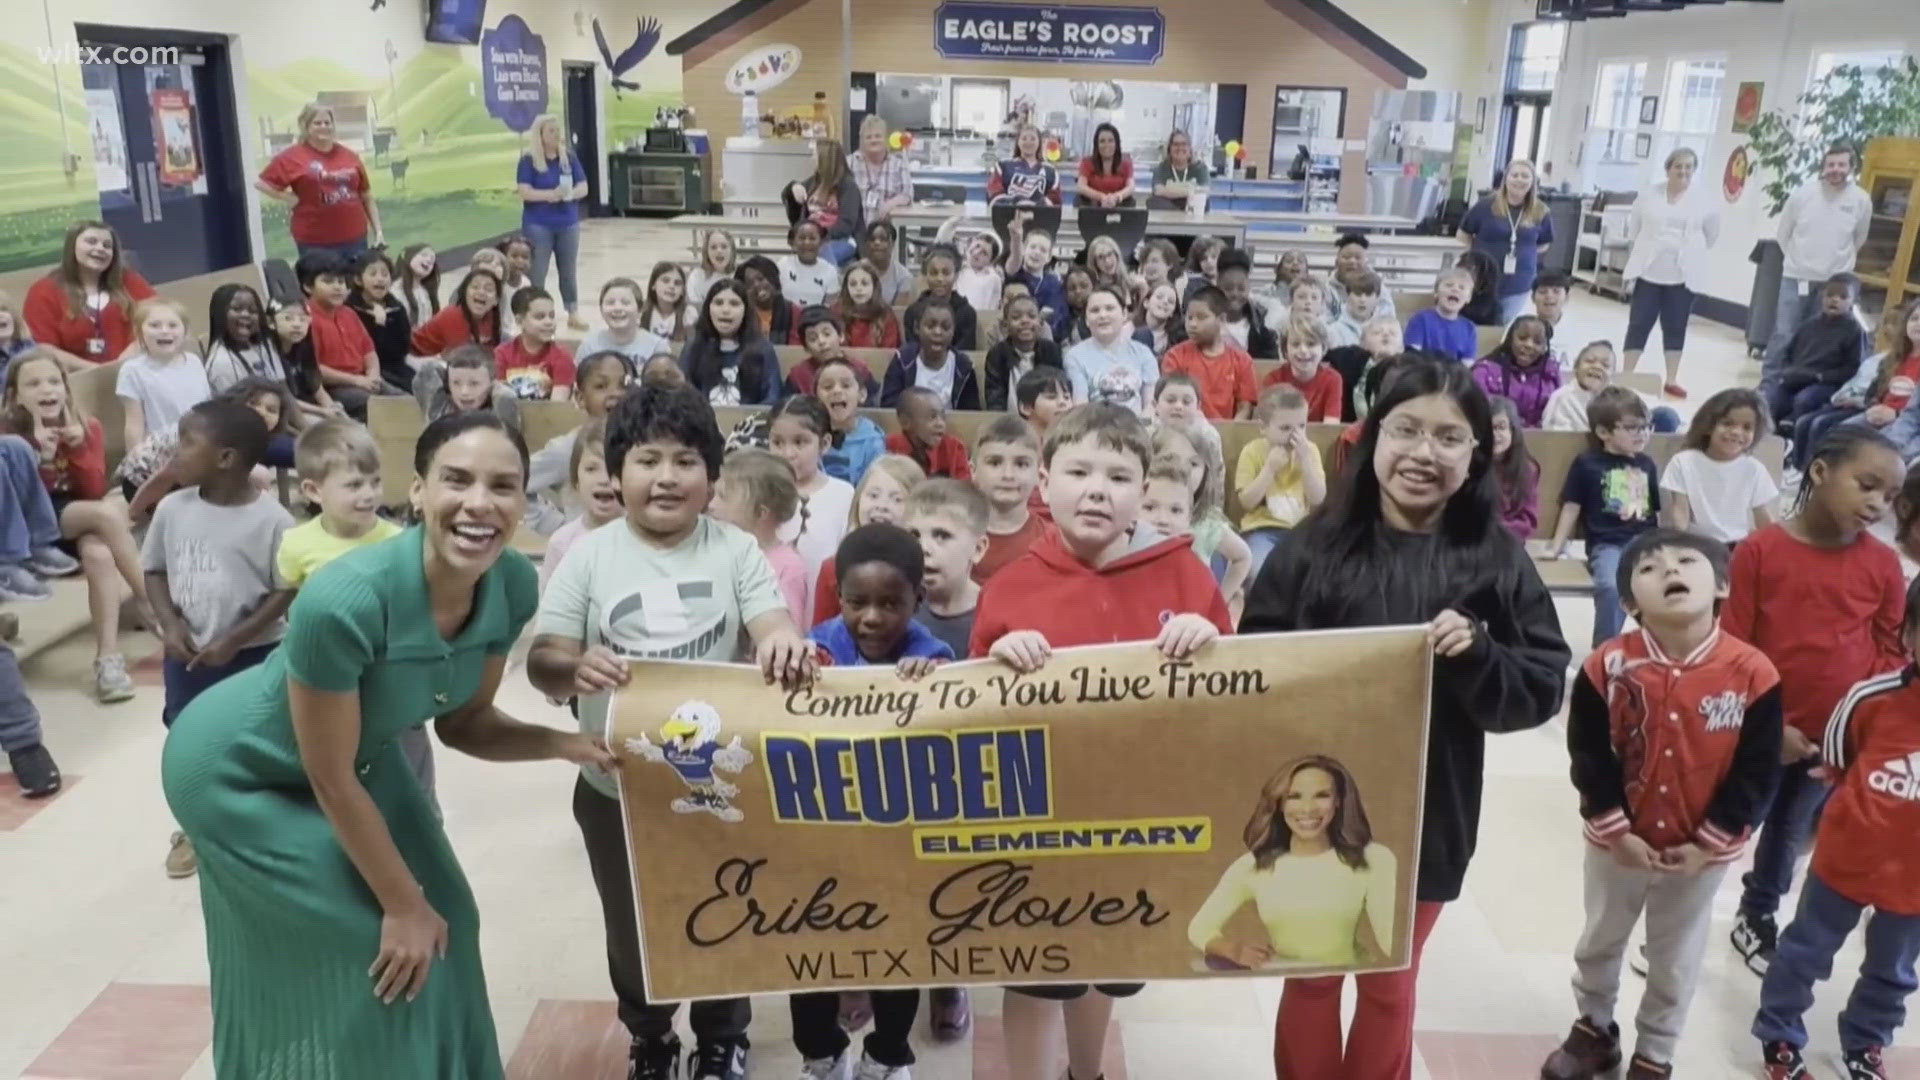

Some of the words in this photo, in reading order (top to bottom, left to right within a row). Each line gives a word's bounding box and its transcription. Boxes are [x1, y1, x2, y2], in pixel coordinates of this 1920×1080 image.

[945, 18, 1052, 42] EAGLE'S
[1063, 23, 1154, 45] ROOST
[785, 685, 923, 728] Coming
[930, 679, 982, 709] To
[987, 673, 1067, 707] You
[1070, 666, 1155, 703] Live
[1159, 660, 1270, 699] From
[1705, 707, 1745, 732] MAN
[764, 727, 1050, 824] REUBEN
[1868, 769, 1920, 802] adi
[920, 823, 1206, 855] ELEMENTARY
[684, 857, 890, 948] Erika
[926, 858, 1171, 947] Glover
[785, 949, 912, 982] WLTX
[930, 944, 1072, 977] NEWS
